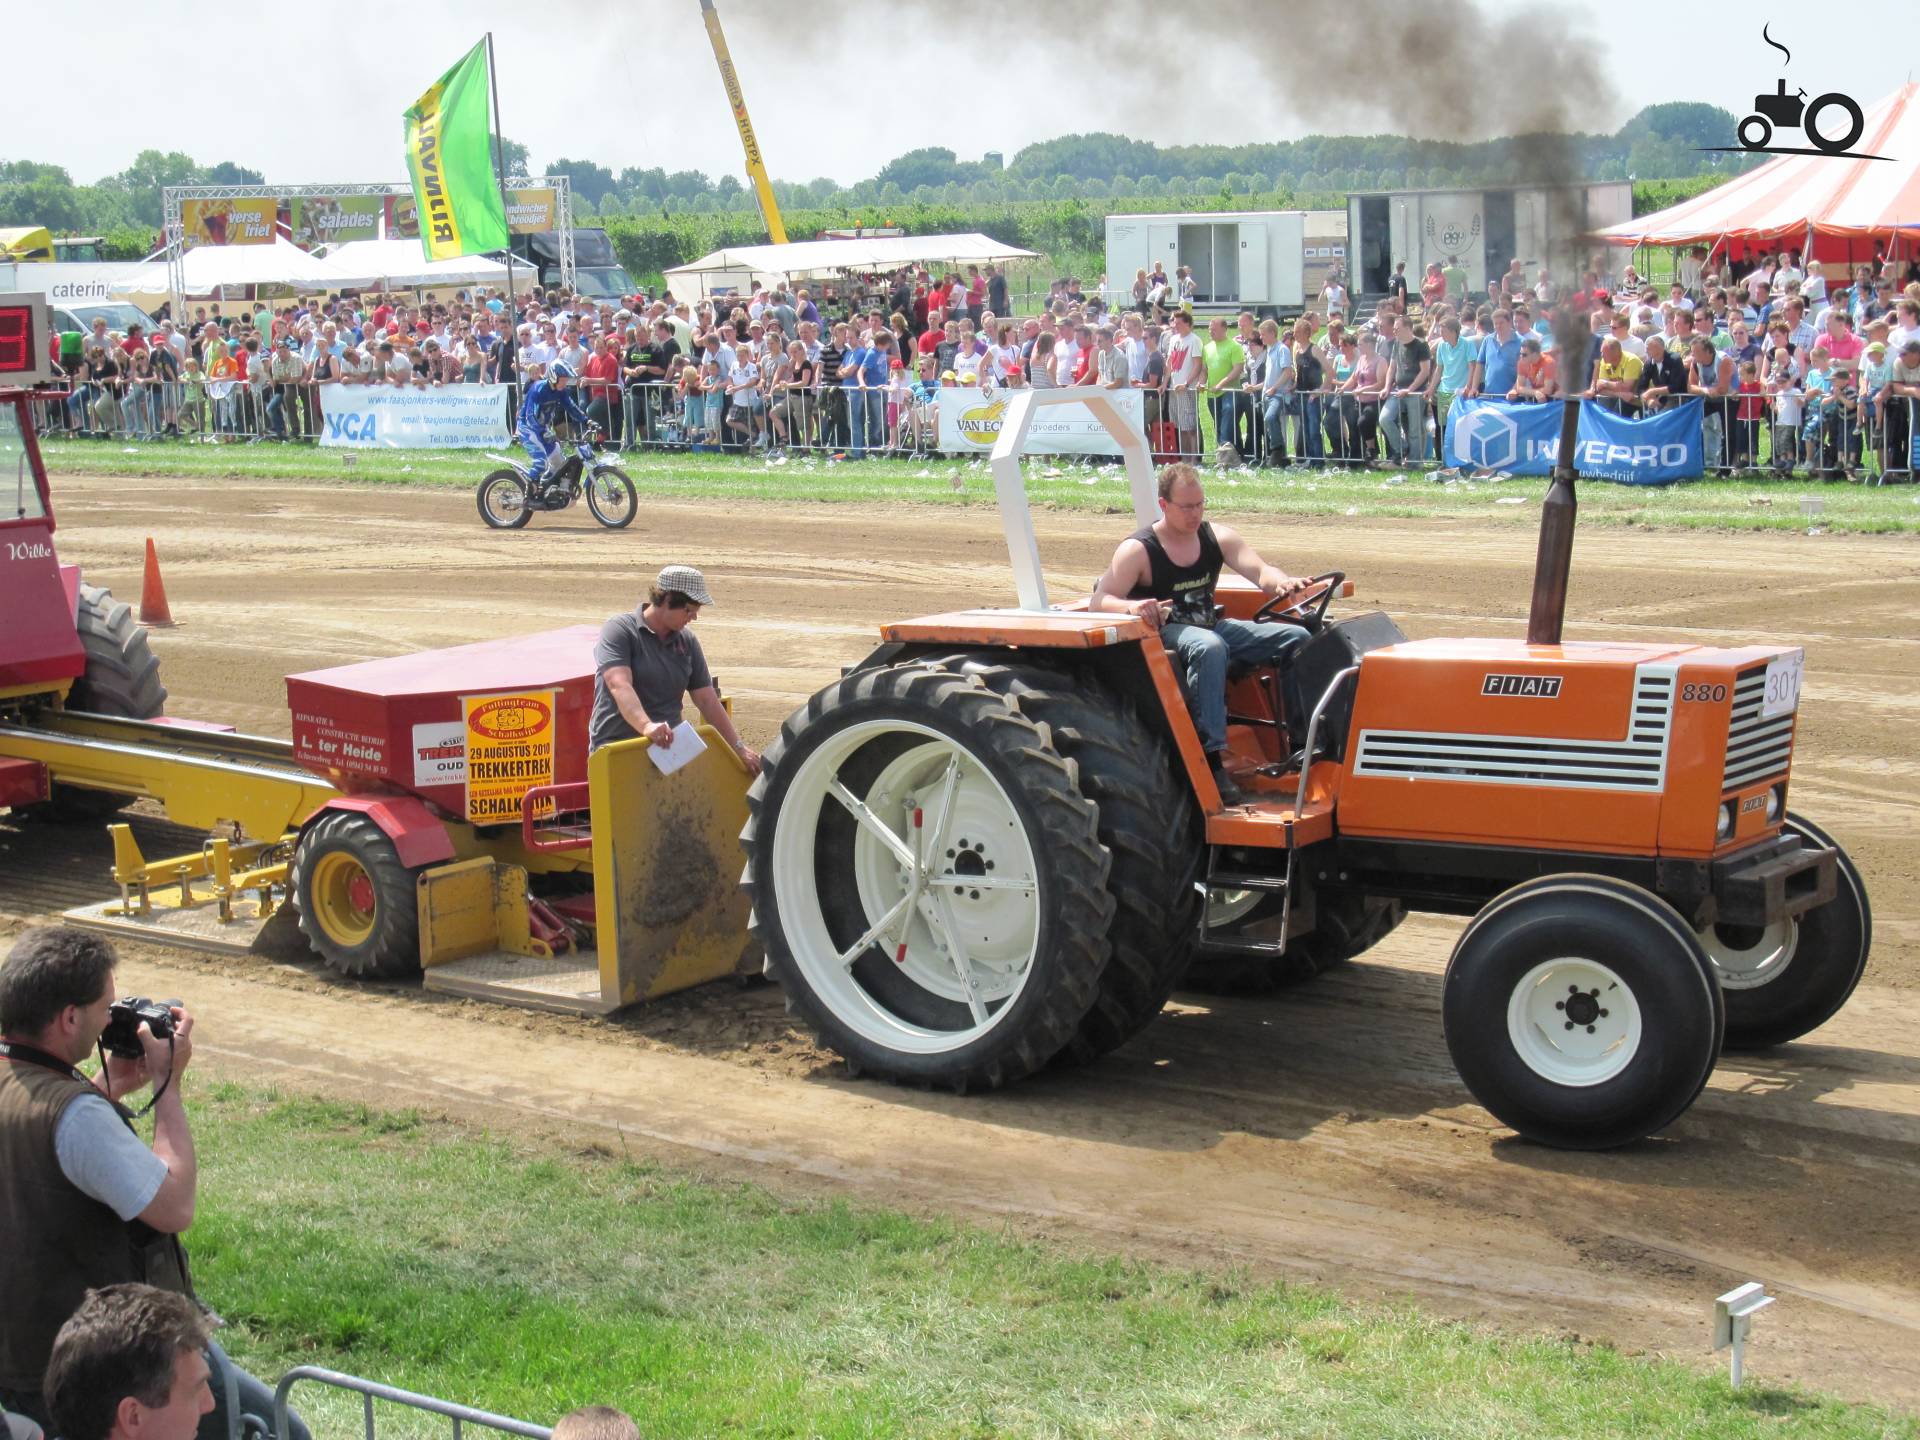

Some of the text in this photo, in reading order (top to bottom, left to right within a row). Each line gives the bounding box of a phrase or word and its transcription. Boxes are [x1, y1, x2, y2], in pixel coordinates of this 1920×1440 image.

[739, 118, 761, 166] H16TPX
[229, 211, 262, 224] verse
[318, 211, 374, 229] salades
[244, 222, 271, 238] friet
[326, 412, 376, 441] VCA
[957, 419, 980, 431] VAN
[1087, 423, 1106, 432] Kun
[1487, 678, 1557, 694] FIAT
[1681, 683, 1726, 702] 880
[1768, 670, 1799, 704] 301
[481, 700, 540, 713] Pullingteam
[487, 727, 537, 738] Schalkwijk
[318, 738, 338, 753] ter
[342, 742, 382, 761] Heide
[470, 742, 550, 760] 29 AUGUSTUS 2010
[469, 757, 551, 779] TREKKERTREK
